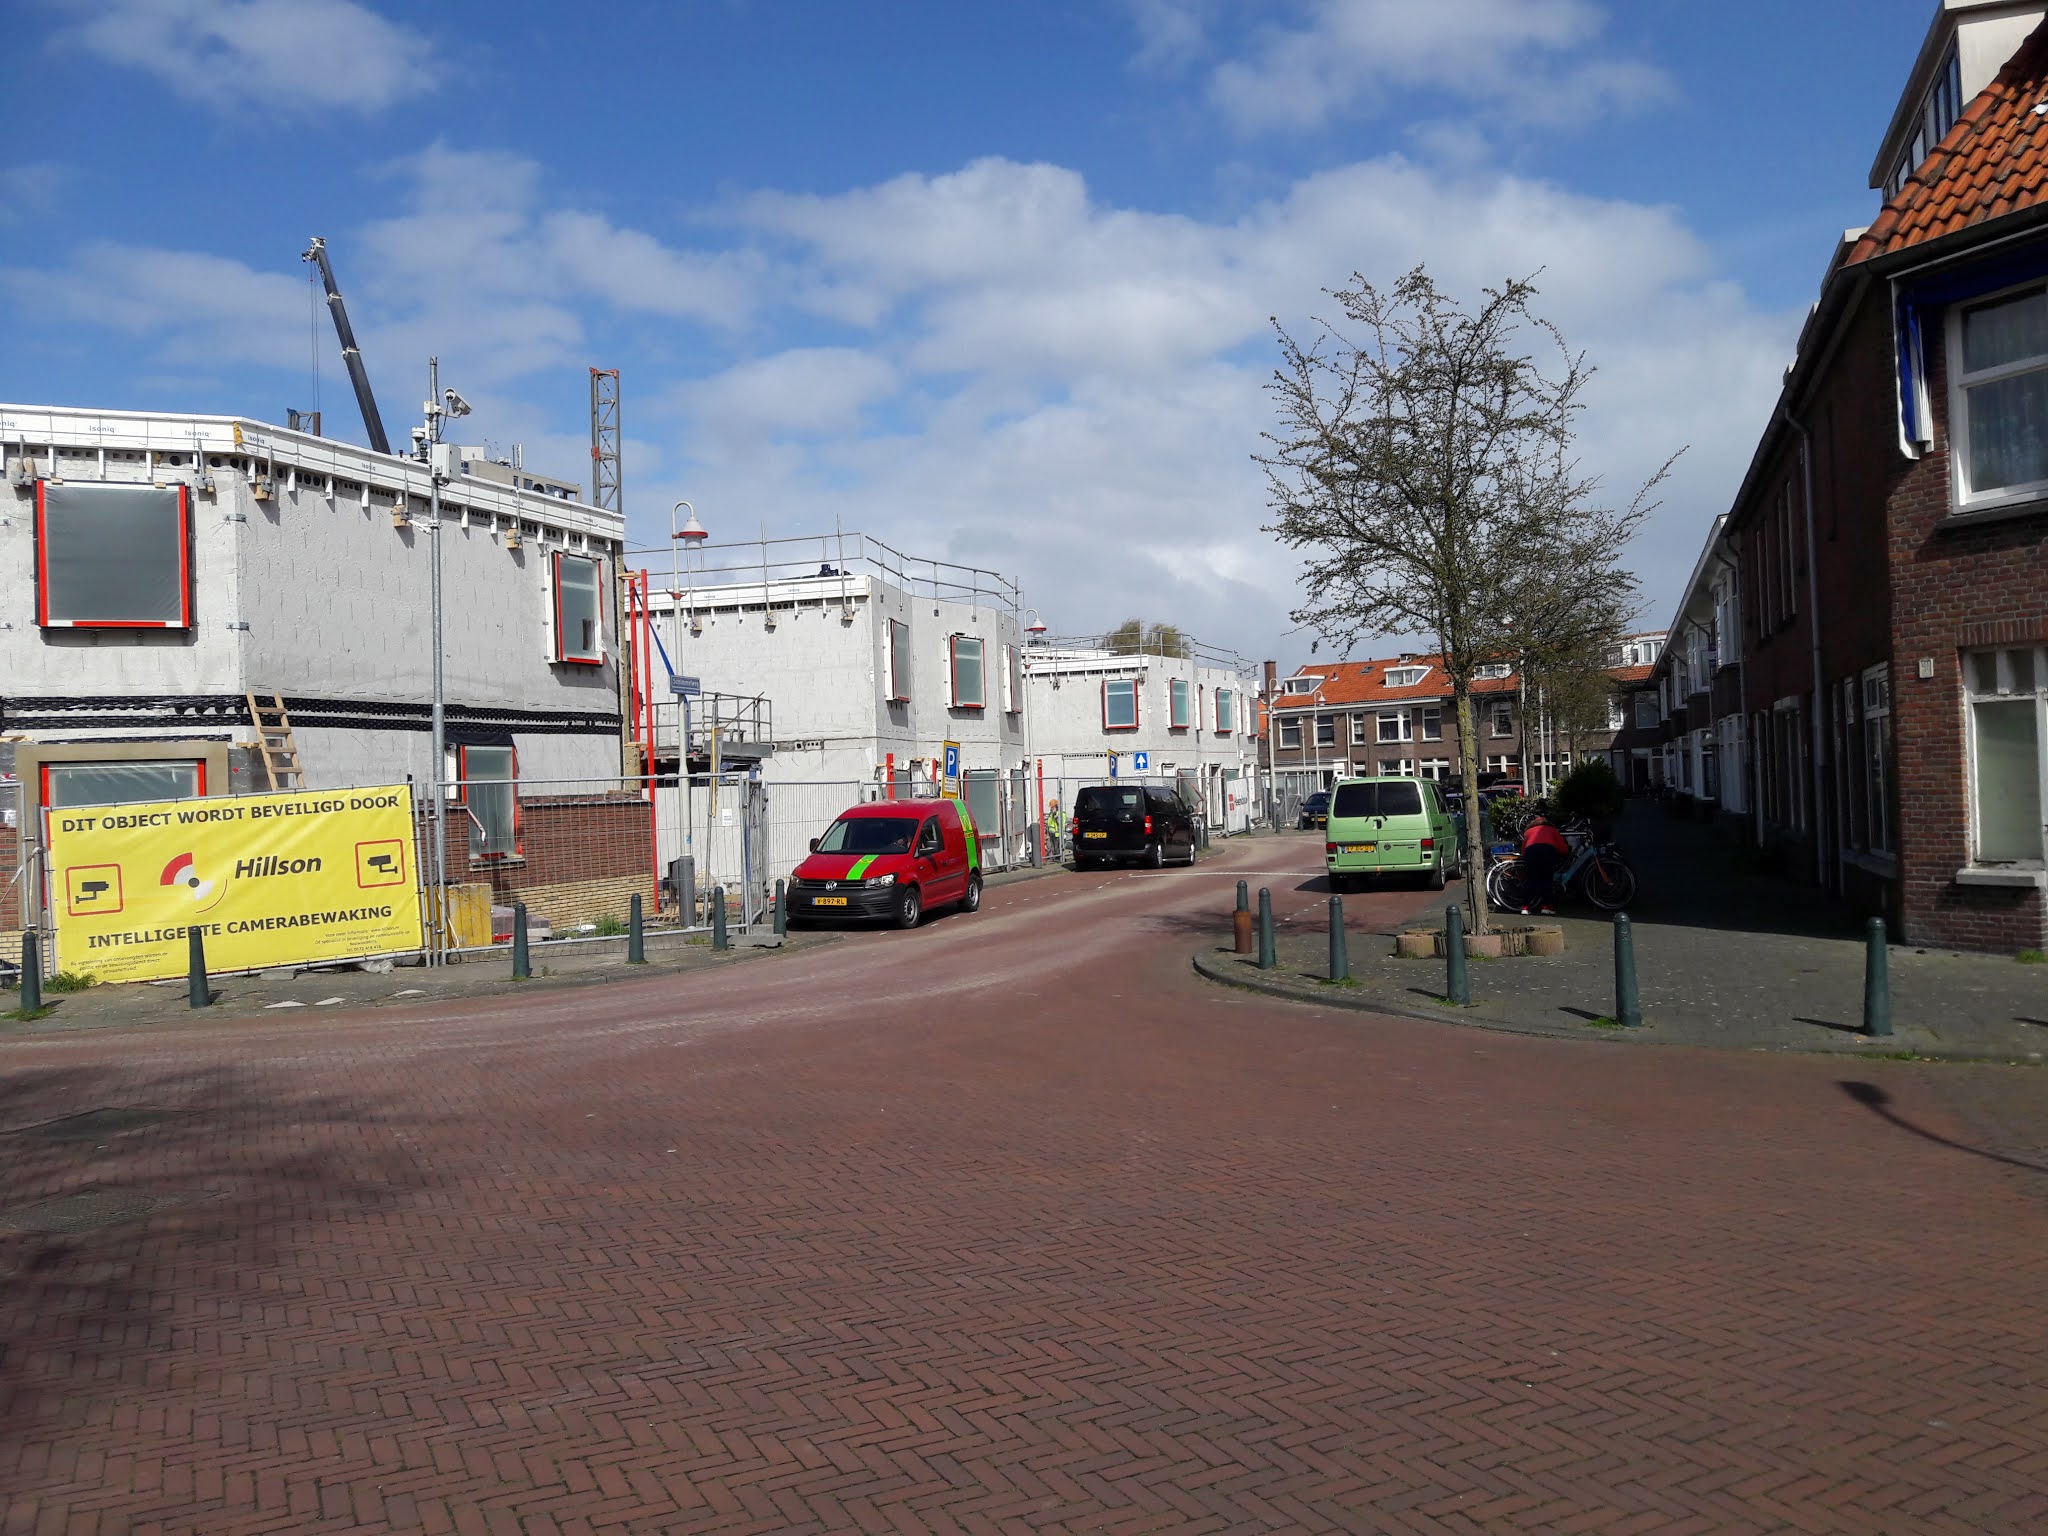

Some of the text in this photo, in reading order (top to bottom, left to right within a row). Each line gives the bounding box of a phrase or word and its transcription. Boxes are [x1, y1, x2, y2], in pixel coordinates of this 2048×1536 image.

[947, 750, 956, 774] P
[62, 795, 399, 833] DIT OBJECT WORDT BEVEILIGD DOOR
[234, 855, 322, 879] Hillson
[88, 905, 392, 949] INTELLIGETE CAMERABEWAKING
